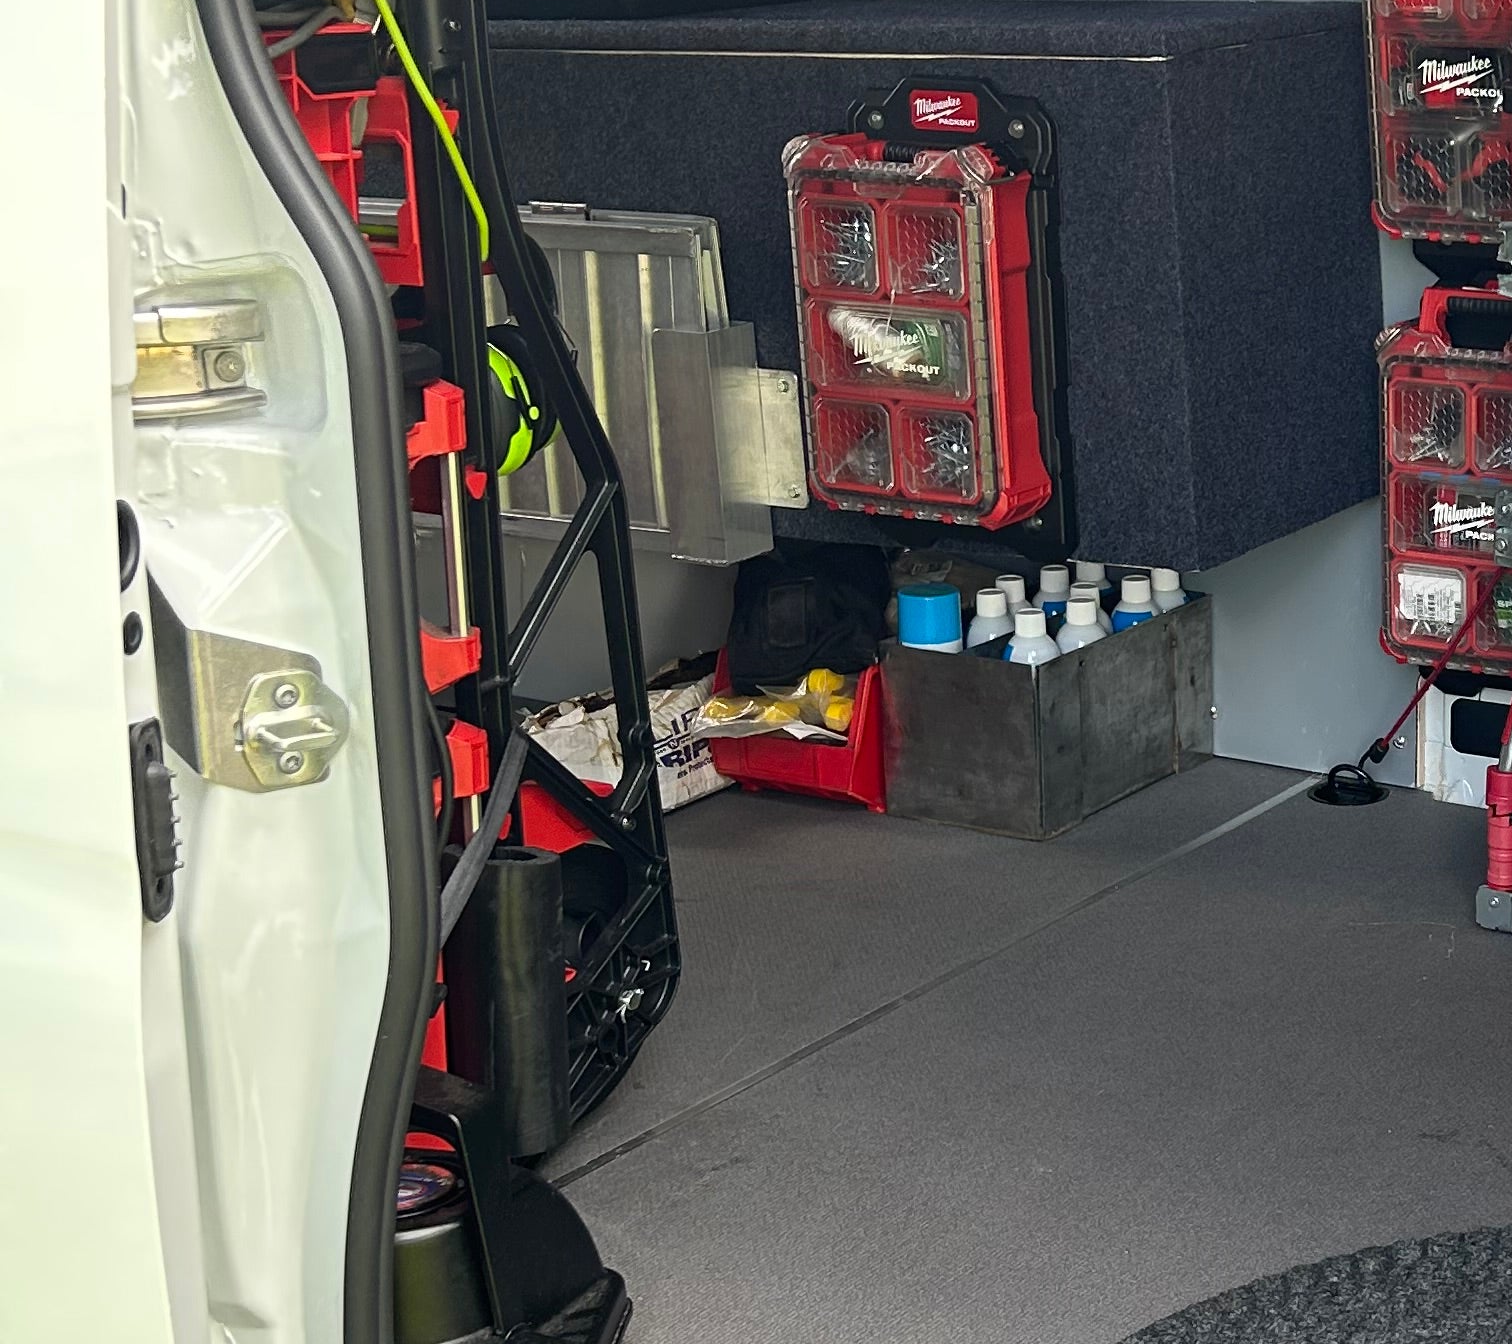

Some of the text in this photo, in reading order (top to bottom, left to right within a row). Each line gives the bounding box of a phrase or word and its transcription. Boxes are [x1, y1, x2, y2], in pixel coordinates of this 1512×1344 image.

[1417, 55, 1493, 86] Milwaukee
[913, 96, 962, 117] Milwaukee
[1429, 502, 1495, 527] Milwauke
